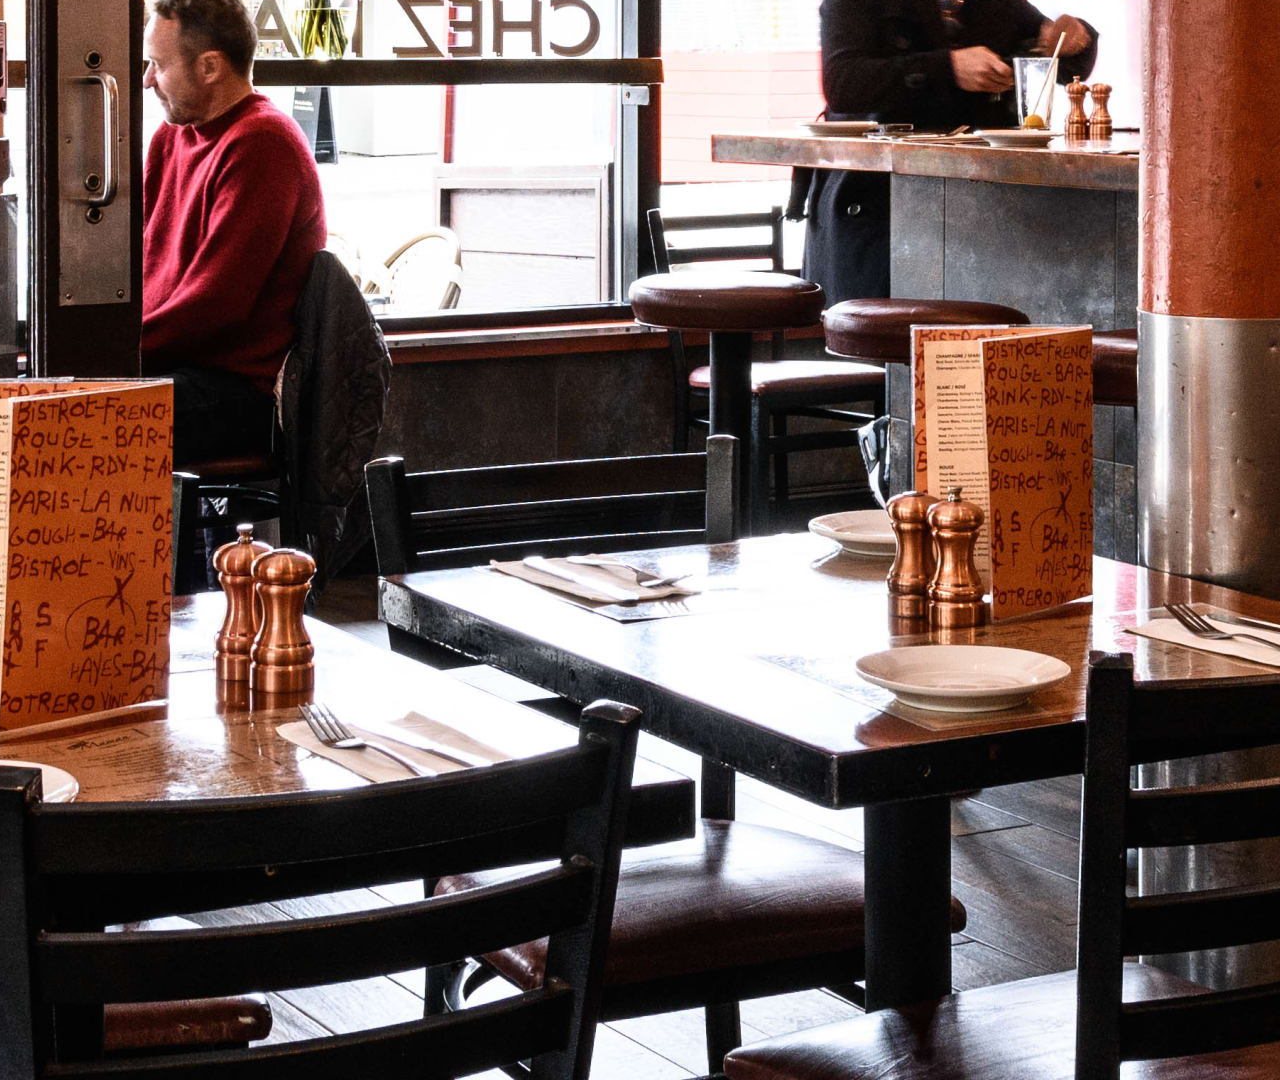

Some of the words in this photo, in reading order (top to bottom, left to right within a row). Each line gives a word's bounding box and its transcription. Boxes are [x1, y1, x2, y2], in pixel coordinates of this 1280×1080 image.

[13, 425, 94, 454] ROUGE
[120, 492, 162, 514] NUIT
[92, 517, 127, 542] BAR
[83, 616, 126, 651] BAR
[1, 691, 95, 715] POTRERO
